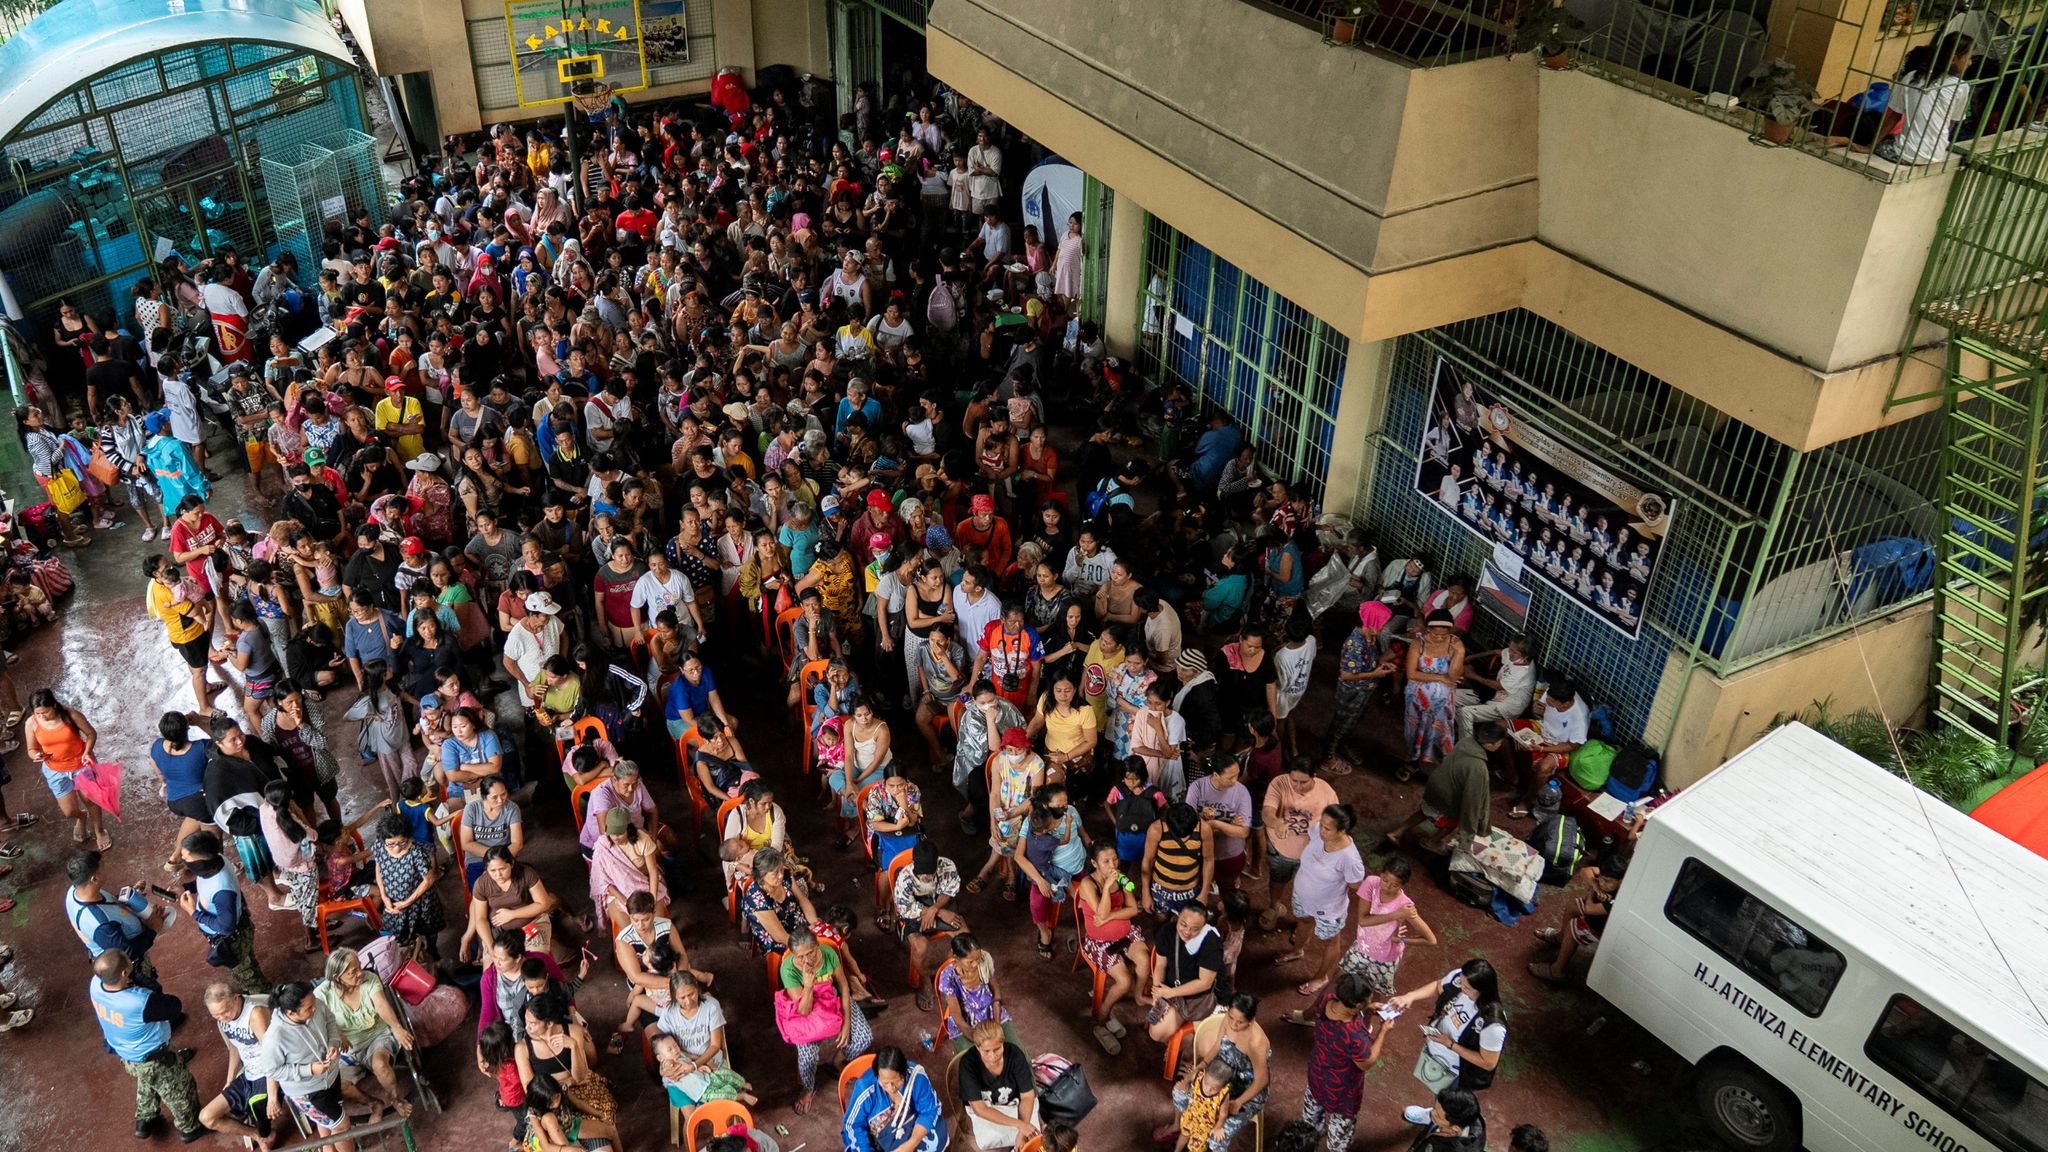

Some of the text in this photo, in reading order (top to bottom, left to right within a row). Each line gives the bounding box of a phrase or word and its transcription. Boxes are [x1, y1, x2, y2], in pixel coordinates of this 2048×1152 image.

[525, 17, 628, 51] KABAKA
[1694, 962, 1786, 1040] H.J.ATIENZA
[1788, 1028, 1905, 1118] ELEMENTARY
